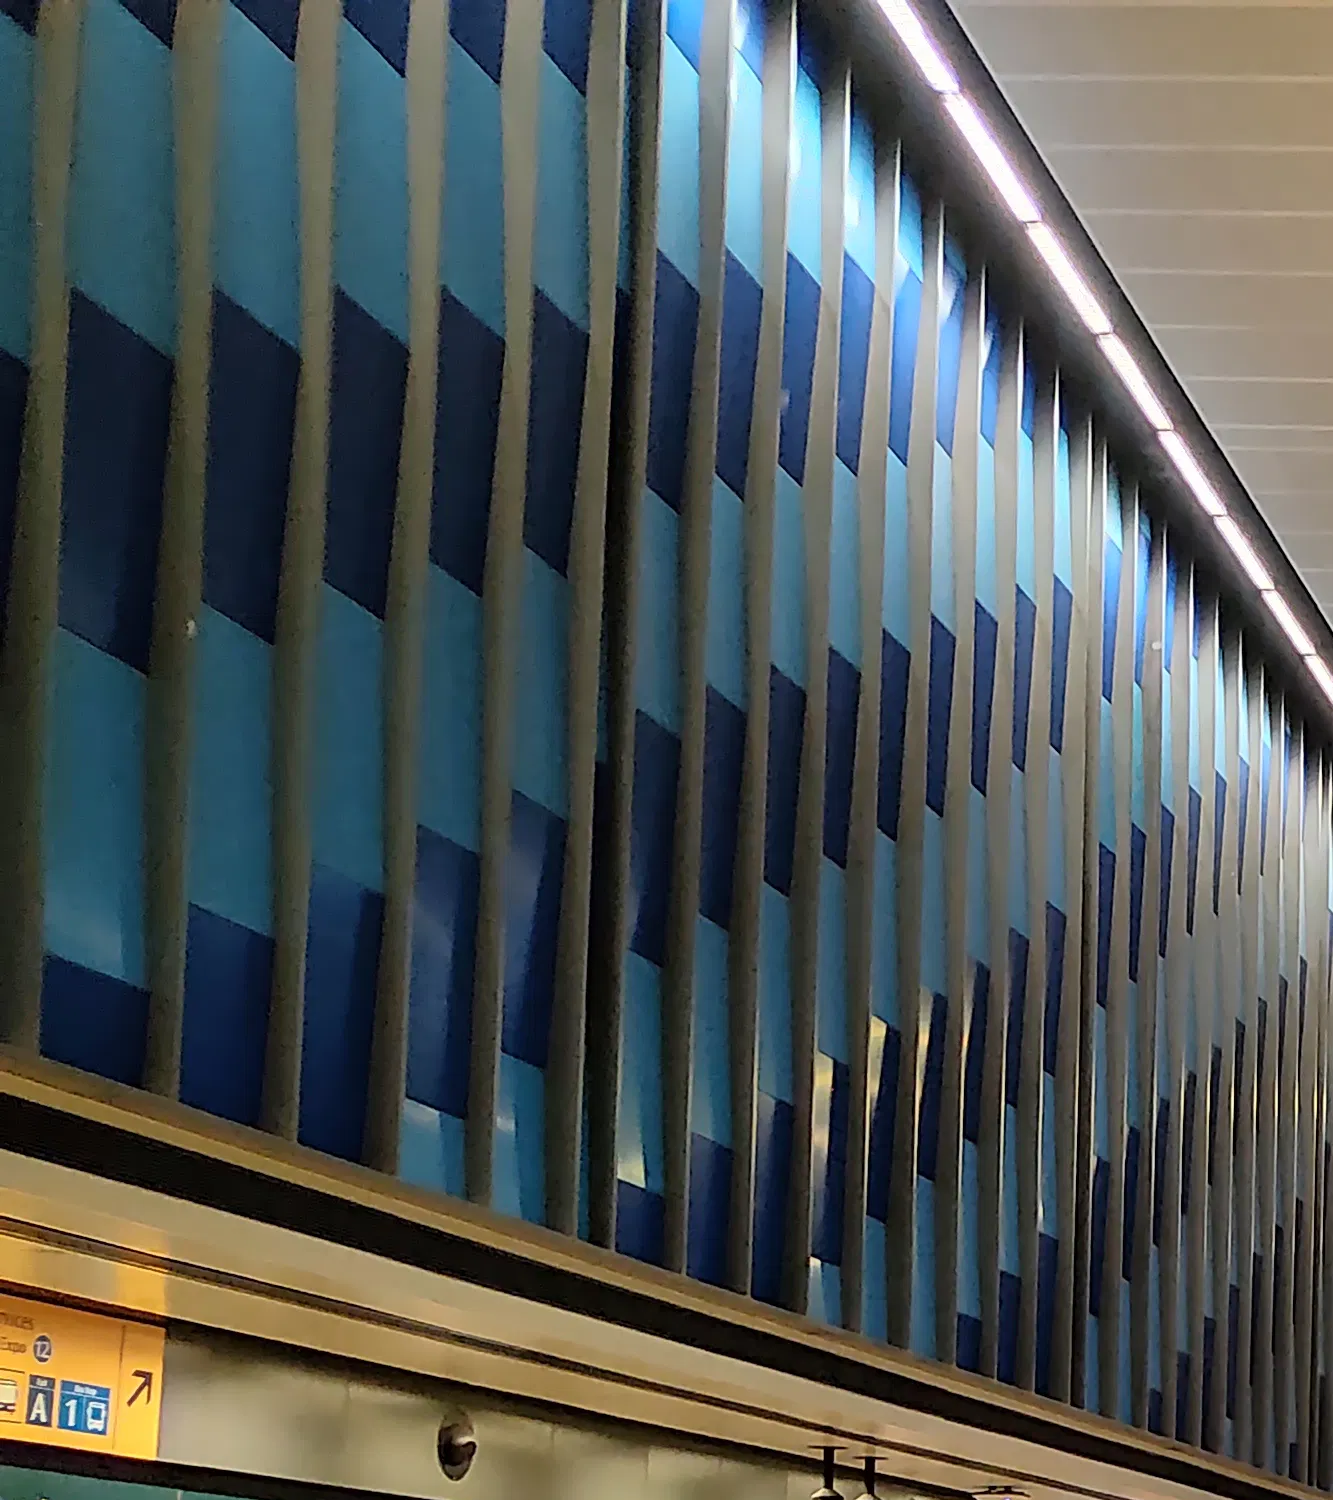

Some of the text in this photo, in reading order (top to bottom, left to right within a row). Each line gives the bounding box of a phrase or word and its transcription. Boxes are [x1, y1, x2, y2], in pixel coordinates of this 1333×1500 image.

[36, 1341, 50, 1358] 12
[30, 1393, 77, 1426] A 1
